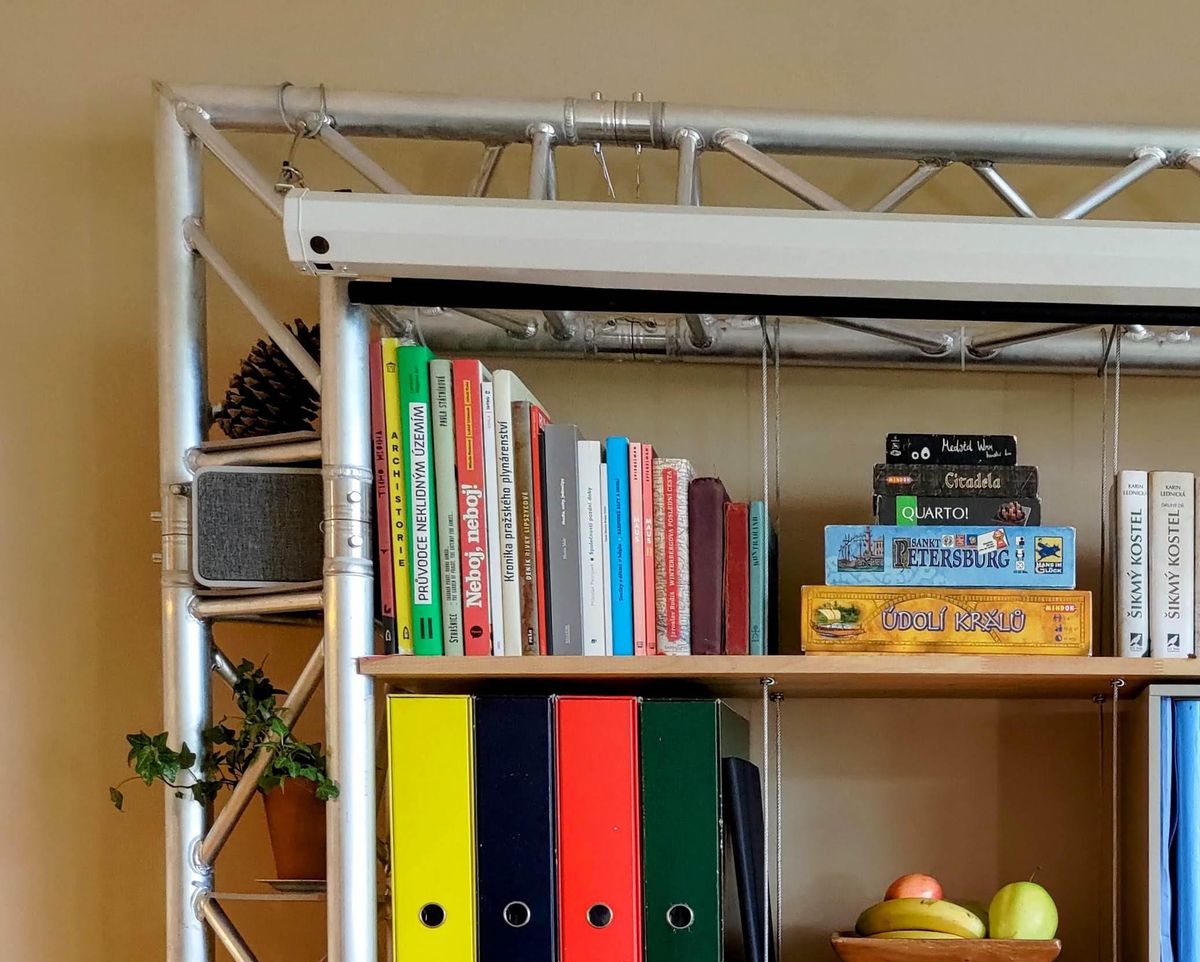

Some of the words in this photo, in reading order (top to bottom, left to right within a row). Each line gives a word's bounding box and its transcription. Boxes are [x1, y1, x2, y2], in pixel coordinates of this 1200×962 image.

[410, 406, 426, 456] ÚZEMÍM
[497, 420, 512, 483] plynárenství
[391, 431, 405, 567] ARCHISTORIE
[412, 461, 428, 531] NEKLIDNÝM
[945, 472, 1001, 489] Citadela
[462, 484, 480, 543] neboj!
[500, 487, 513, 539] pražského
[902, 506, 969, 522] QUARTO!
[1131, 509, 1142, 565] KOSTEL
[1168, 509, 1180, 566] KOSTEL
[412, 536, 429, 600] PRŮVODCE
[502, 543, 514, 581] Kronika
[893, 539, 1010, 571] PETERSBURG
[911, 539, 941, 547] SANKT
[464, 546, 484, 607] Neboj,
[524, 559, 532, 580] DENÍK
[1127, 570, 1142, 619] ŠIKMÝ
[882, 607, 945, 631] ÚDOLÍ
[955, 607, 1026, 632] KRÁLŮ
[1165, 571, 1180, 619] ŠIKMÝ
